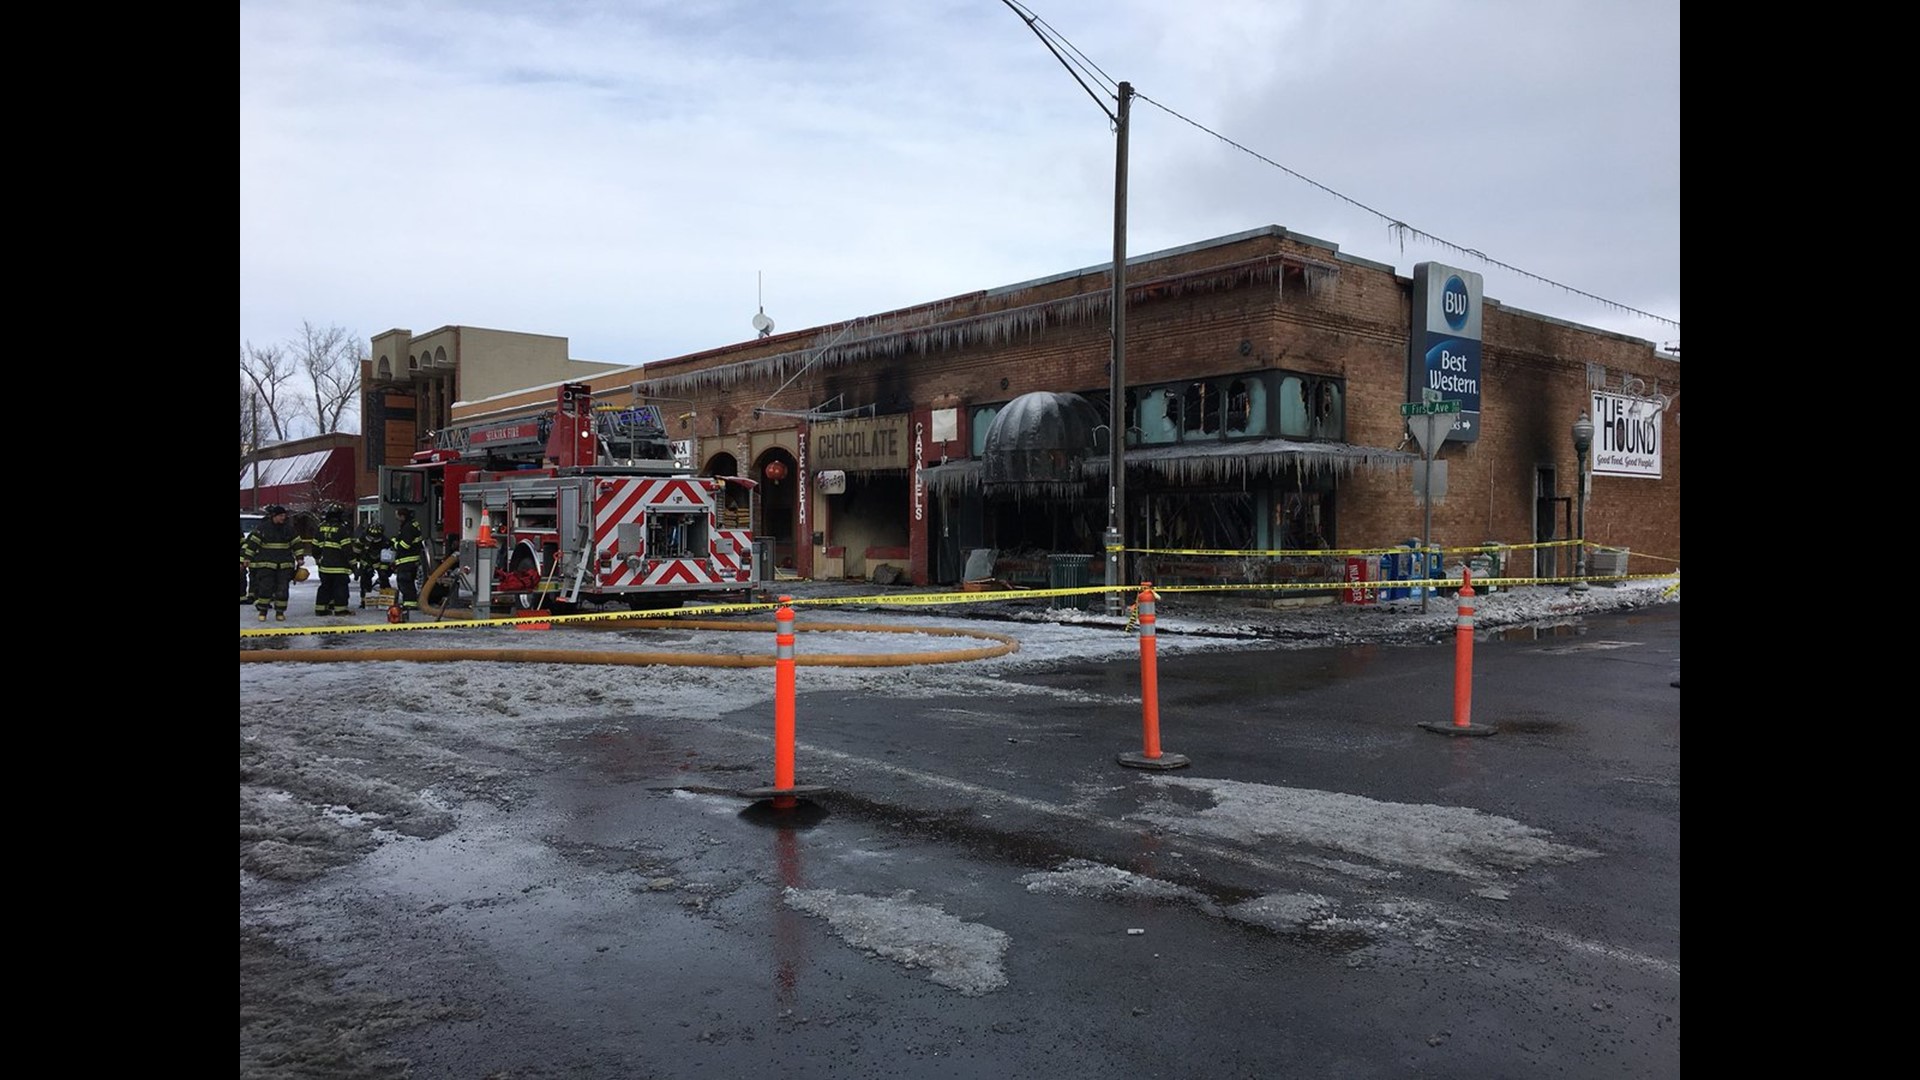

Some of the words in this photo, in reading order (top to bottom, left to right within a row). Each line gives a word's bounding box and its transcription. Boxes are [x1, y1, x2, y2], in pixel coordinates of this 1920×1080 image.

[1445, 291, 1467, 315] BW
[1441, 350, 1467, 373] Best
[1429, 369, 1477, 394] Western
[1434, 402, 1450, 413] Ave
[507, 426, 520, 439] FIRE
[1603, 398, 1656, 455] HOUND
[818, 429, 898, 460] CHOCOLATE
[1597, 454, 1610, 466] Good
[1624, 456, 1637, 467] Good
